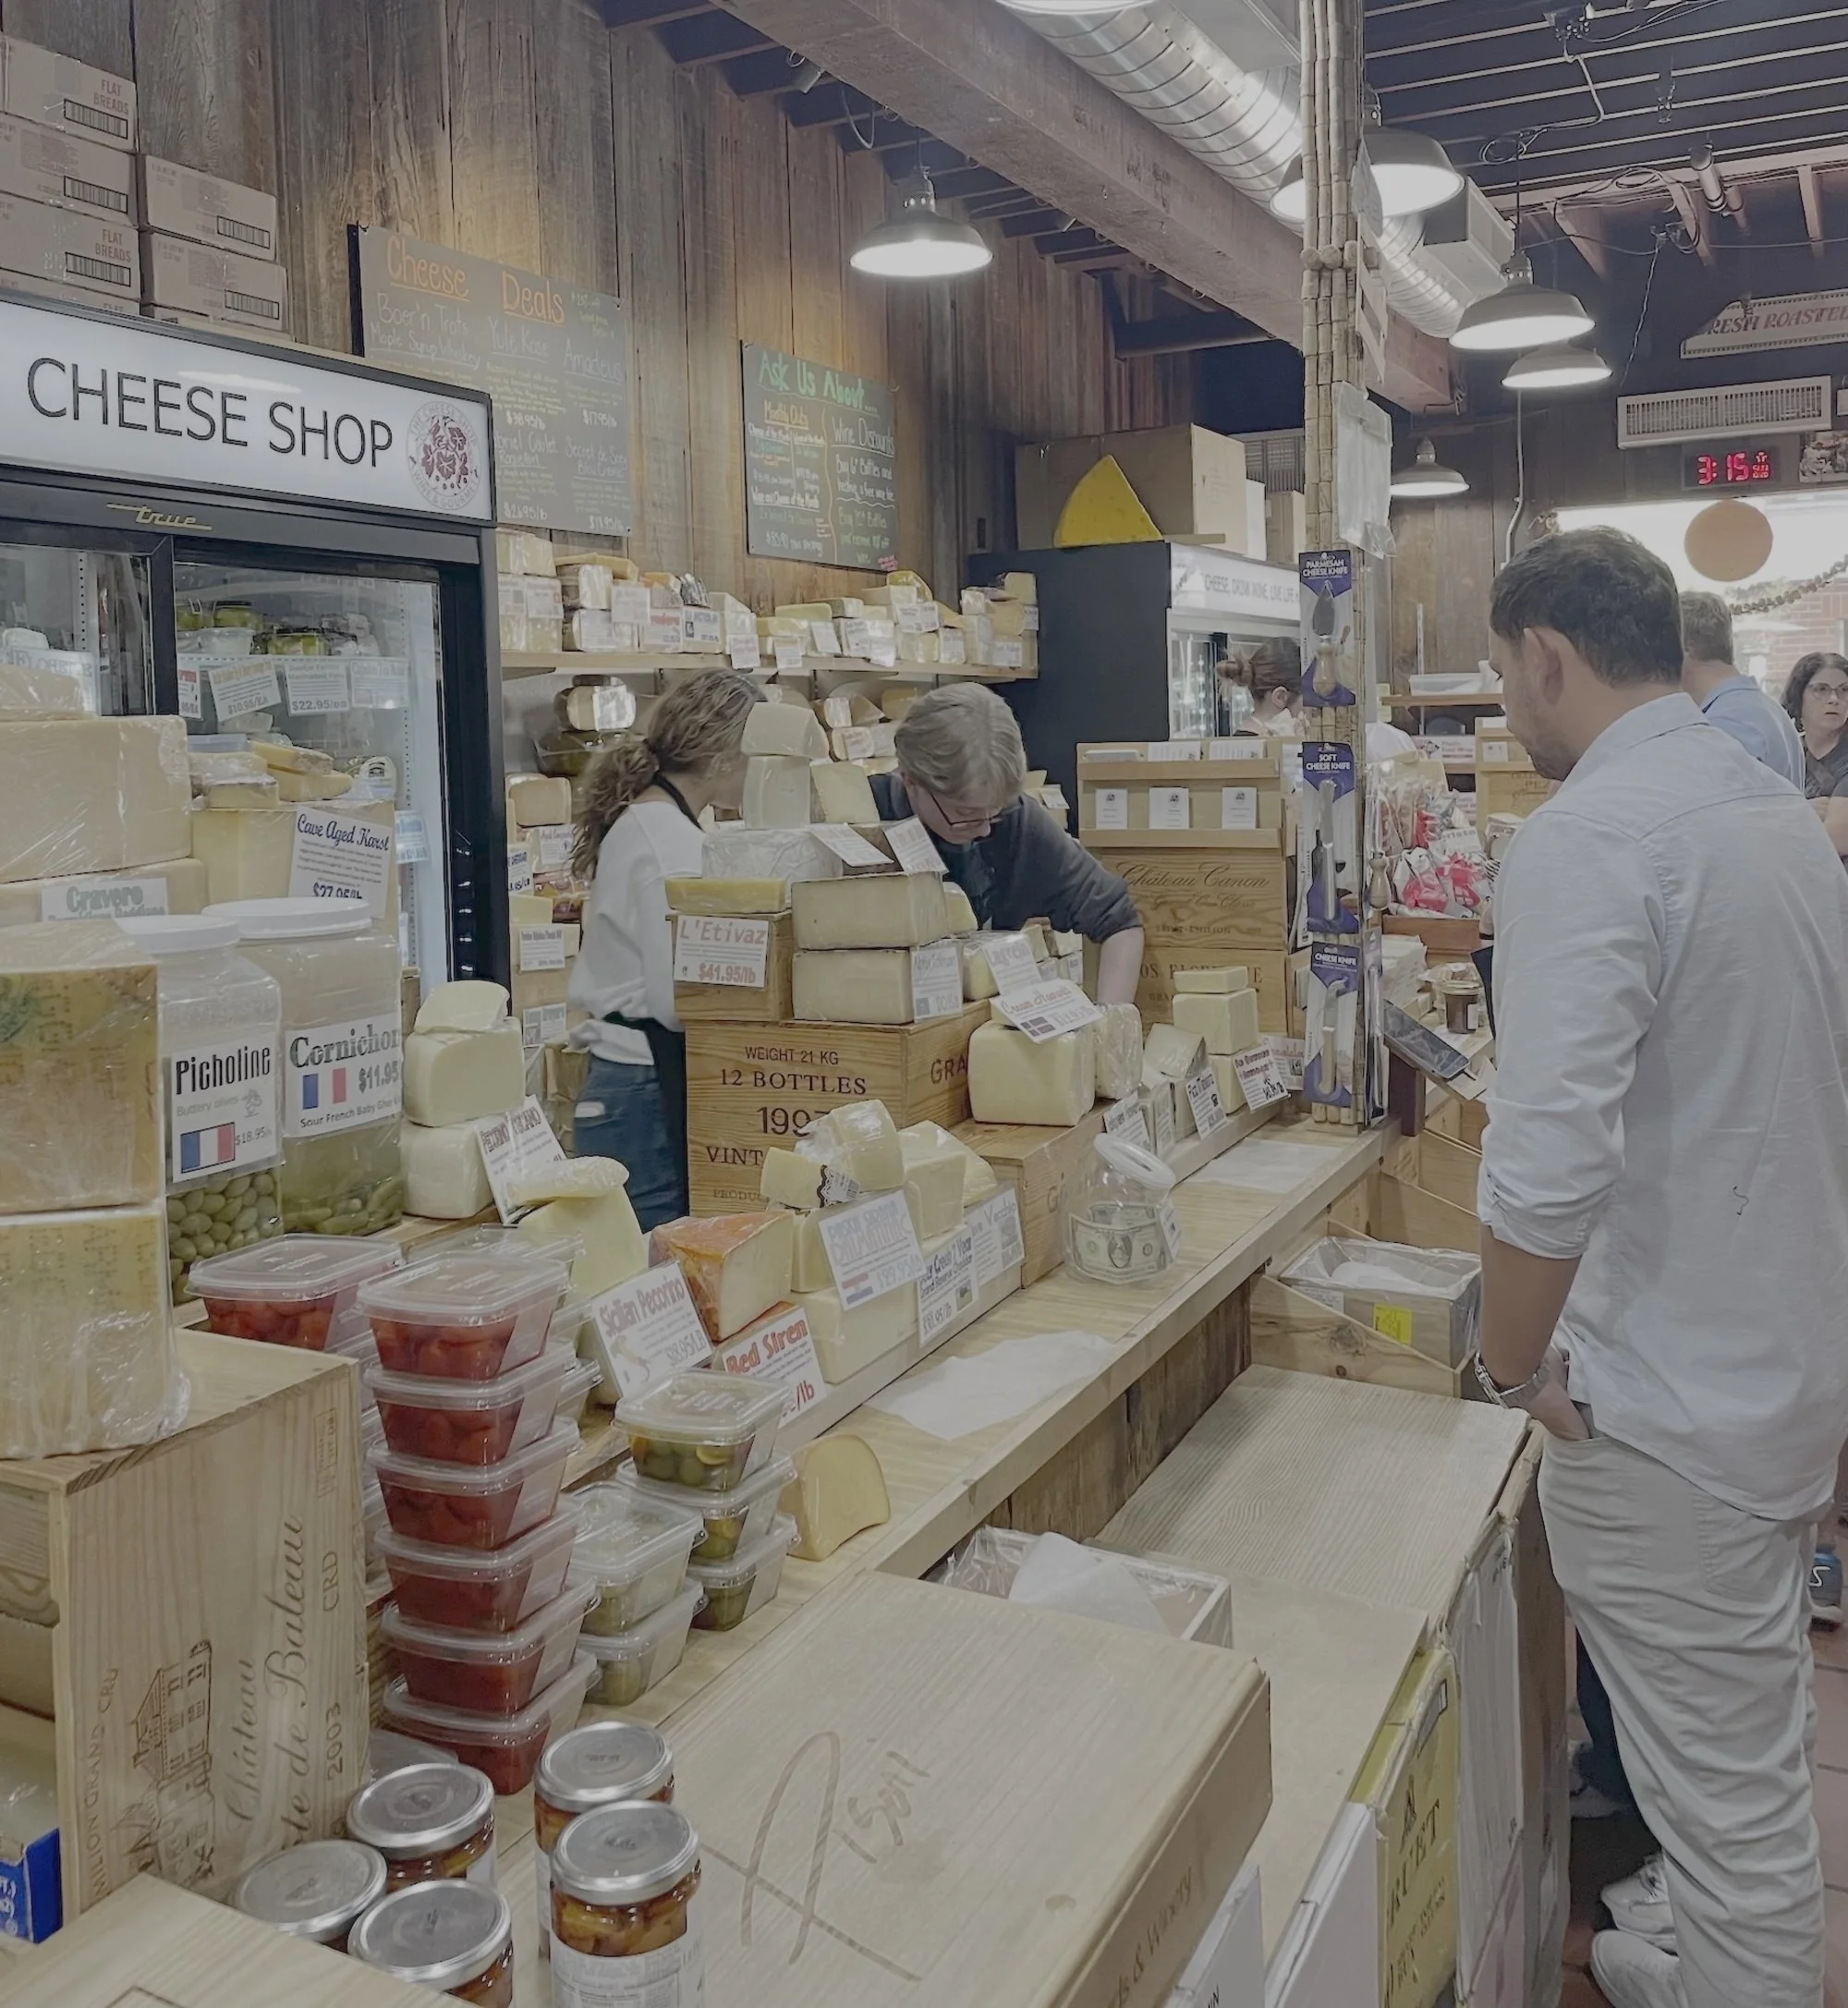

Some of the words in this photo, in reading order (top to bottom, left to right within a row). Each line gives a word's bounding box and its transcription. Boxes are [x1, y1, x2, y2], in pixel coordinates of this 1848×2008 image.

[101, 79, 122, 95] FLAT
[93, 93, 128, 115] BREADS
[102, 228, 123, 245] FLAT
[95, 242, 131, 263] BREADS
[387, 235, 469, 298] Cheese
[502, 271, 565, 323] Deals
[1708, 310, 1760, 335] RESH
[759, 350, 791, 391] Ask
[796, 359, 816, 396] Us
[27, 358, 249, 448] CHEESE
[269, 400, 393, 468] SHOP
[1303, 568, 1328, 577] CHEESE
[1329, 566, 1348, 575] KNIFE
[1306, 559, 1344, 569] PARMESAN
[1319, 753, 1337, 761] SOFT
[298, 813, 324, 836] Cave
[325, 820, 357, 846] Aged
[357, 827, 390, 850] Karst
[67, 886, 143, 913] Cravero
[680, 919, 767, 944] L'Etivaz
[1315, 952, 1338, 962] CHEESE
[1338, 955, 1357, 967] KNIFE
[745, 1046, 796, 1062] WEIGHT
[800, 1050, 814, 1065] 21
[821, 1051, 840, 1065] KG
[176, 1046, 271, 1095] Picholine
[721, 1068, 744, 1087] 12
[753, 1070, 867, 1096] BOTTLES
[930, 1055, 968, 1085] GRA
[176, 1101, 212, 1116] Buttery
[300, 1118, 325, 1129] Sour
[326, 1110, 355, 1124] French
[357, 1103, 377, 1119] Baby
[756, 1106, 830, 1138] 199
[706, 1146, 764, 1167] VINT
[600, 1297, 641, 1338] Sicilian
[636, 1275, 687, 1320] Pecorino
[726, 1341, 761, 1375] Red
[762, 1319, 809, 1361] Siren
[322, 1551, 339, 1612] CRD
[274, 1721, 310, 1778] de
[325, 1701, 345, 1782] 2003
[87, 1815, 106, 1896] MILION
[97, 1667, 119, 1714] CRU
